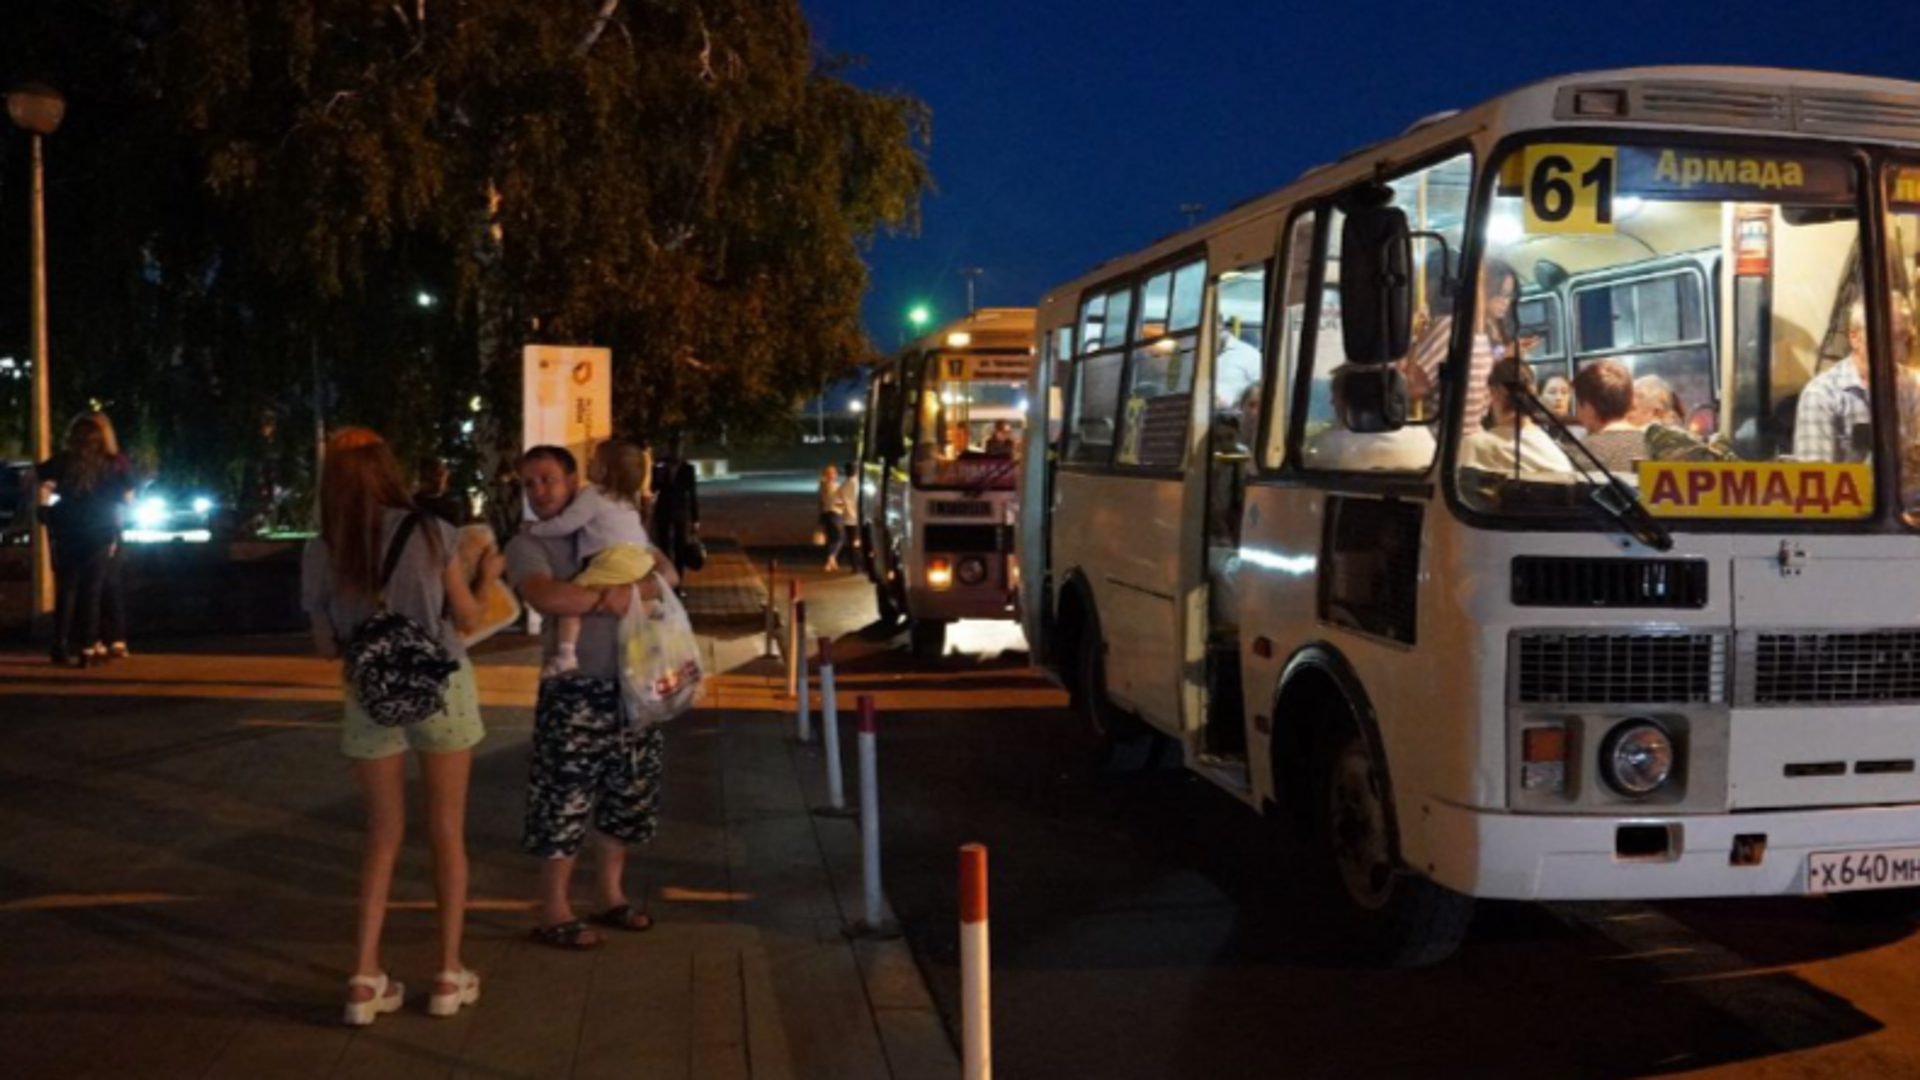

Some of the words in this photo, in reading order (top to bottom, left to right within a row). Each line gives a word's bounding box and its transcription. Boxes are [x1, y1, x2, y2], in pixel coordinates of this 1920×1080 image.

[1530, 154, 1613, 225] 61
[1654, 150, 1803, 190] Армада
[1651, 470, 1862, 513] АРМАДА
